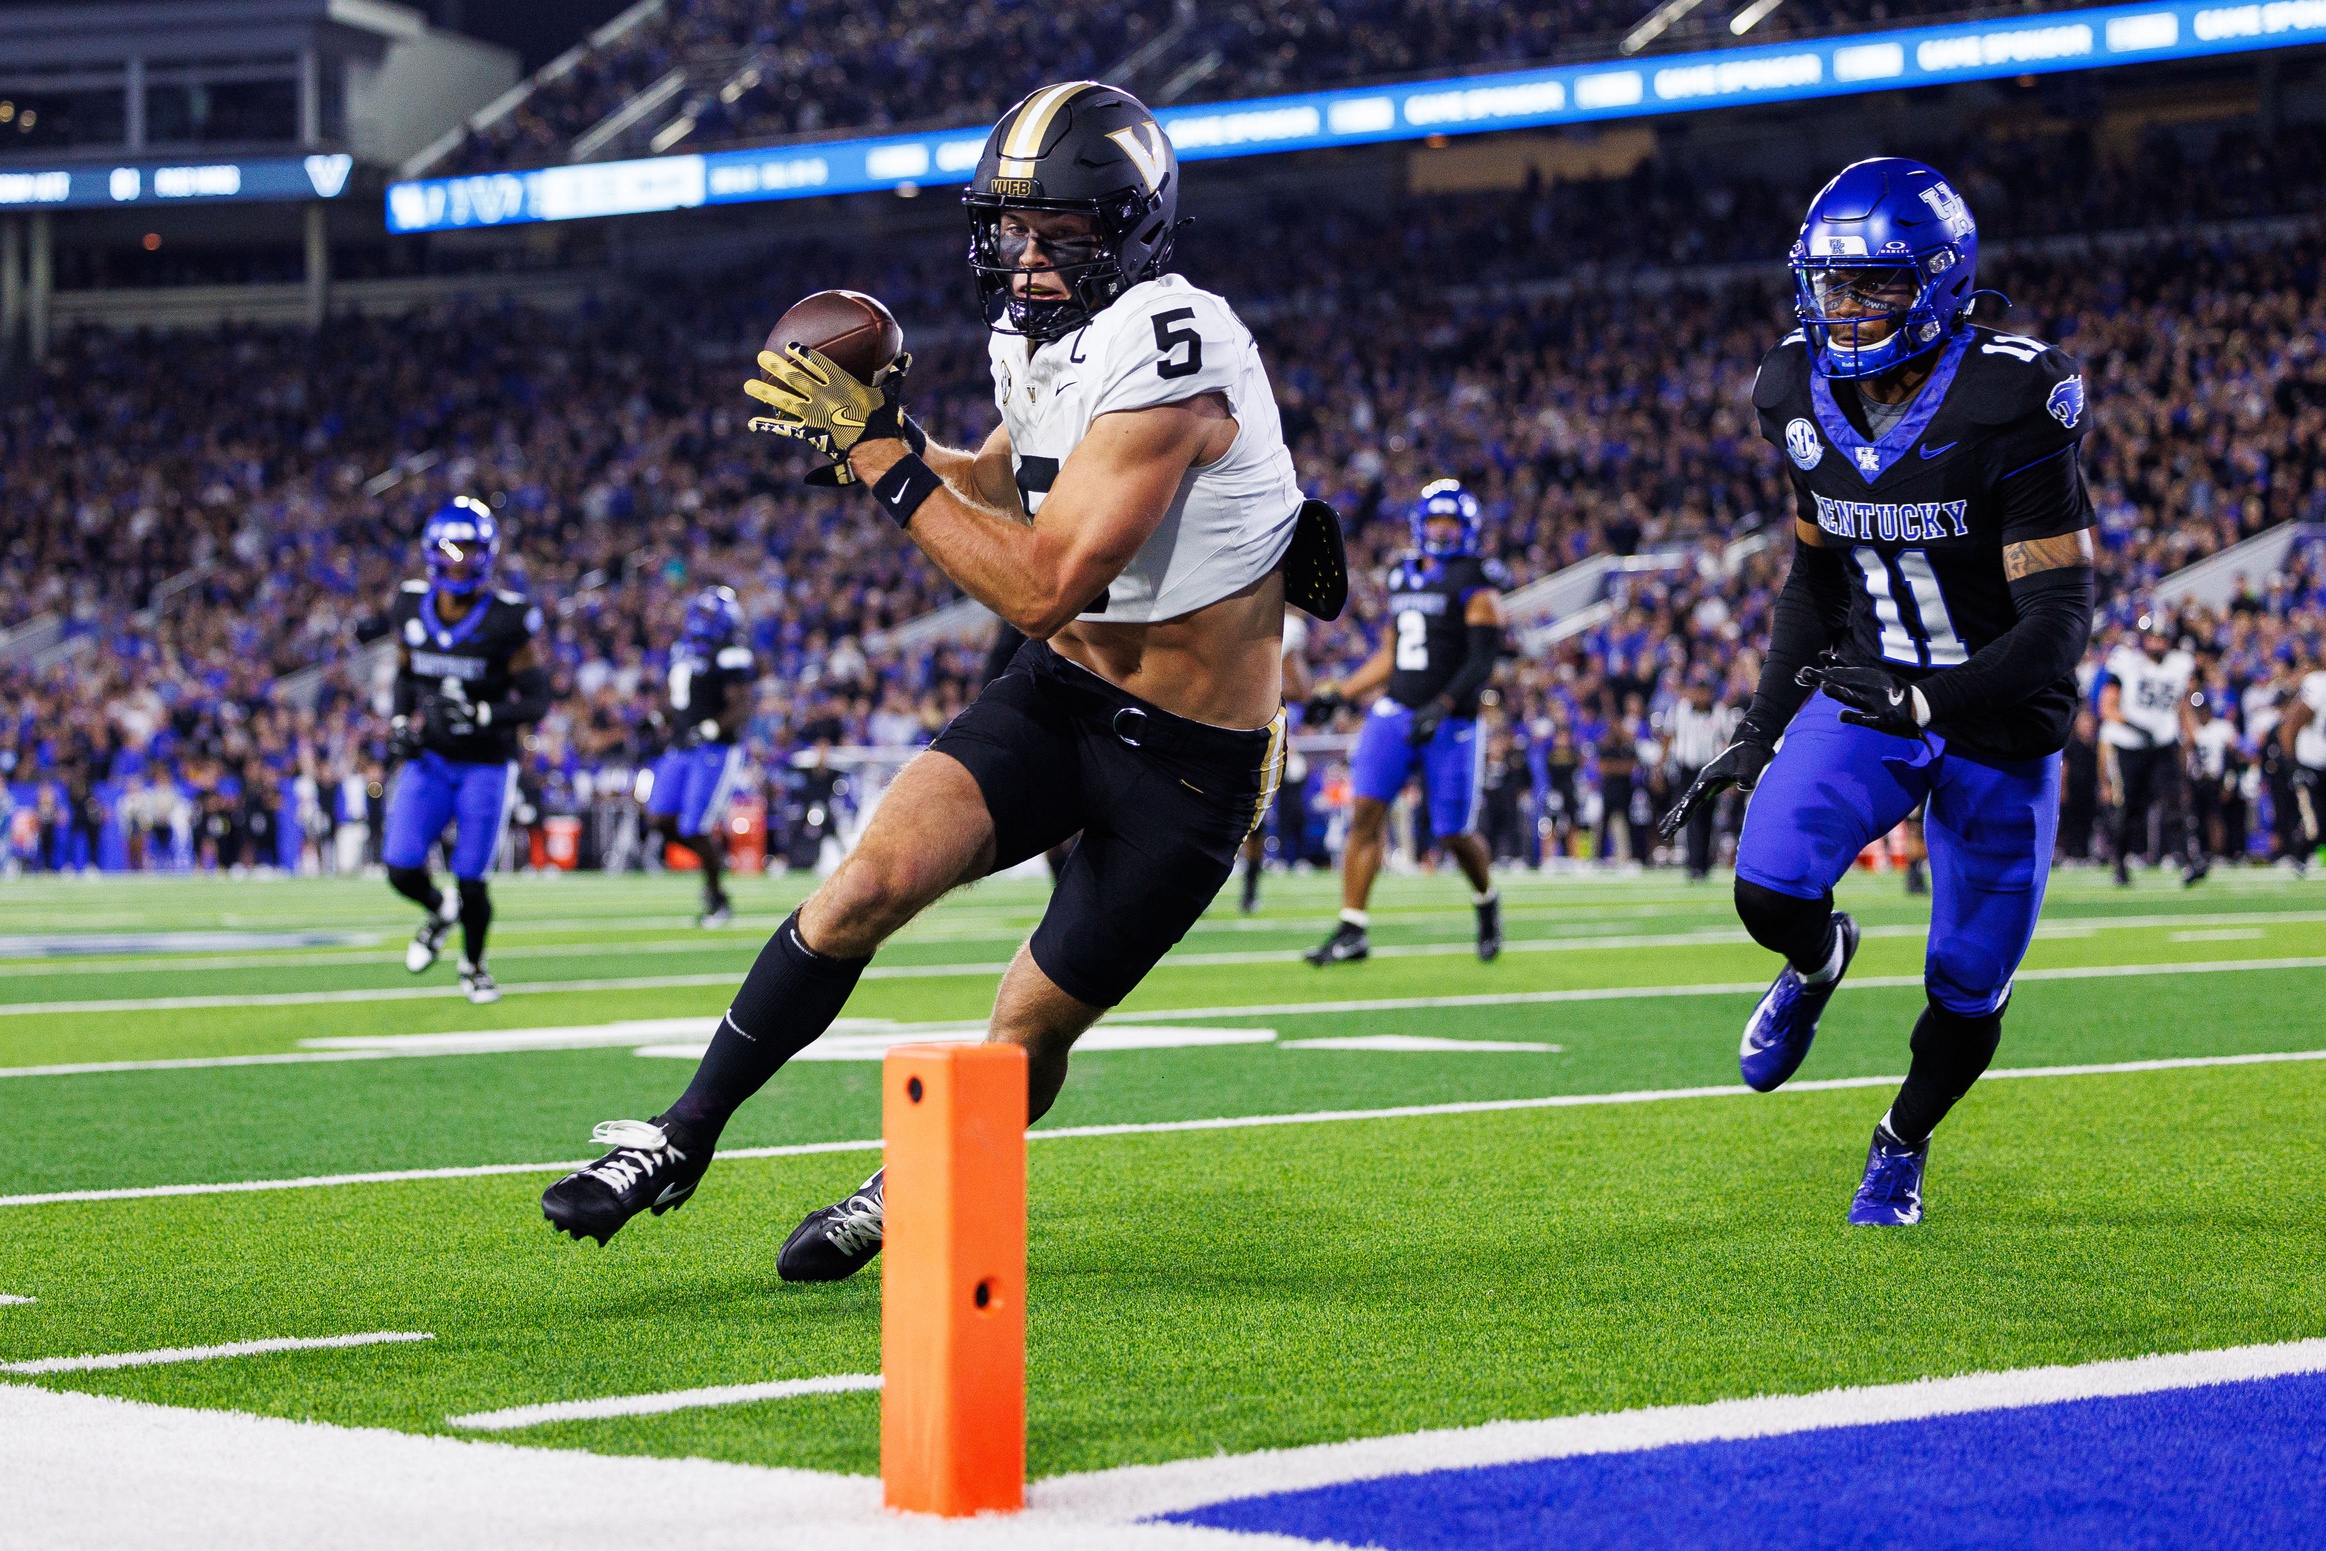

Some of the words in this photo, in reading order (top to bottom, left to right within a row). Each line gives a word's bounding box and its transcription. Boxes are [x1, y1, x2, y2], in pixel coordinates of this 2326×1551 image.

[1104, 120, 1168, 194] V
[991, 179, 1030, 196] VUFB
[1150, 307, 1202, 380] 5
[1982, 335, 2049, 363] 11
[1786, 419, 1816, 457] SEC
[1855, 447, 1880, 471] UK
[1851, 545, 1971, 668] 11
[1396, 609, 1429, 672] 2
